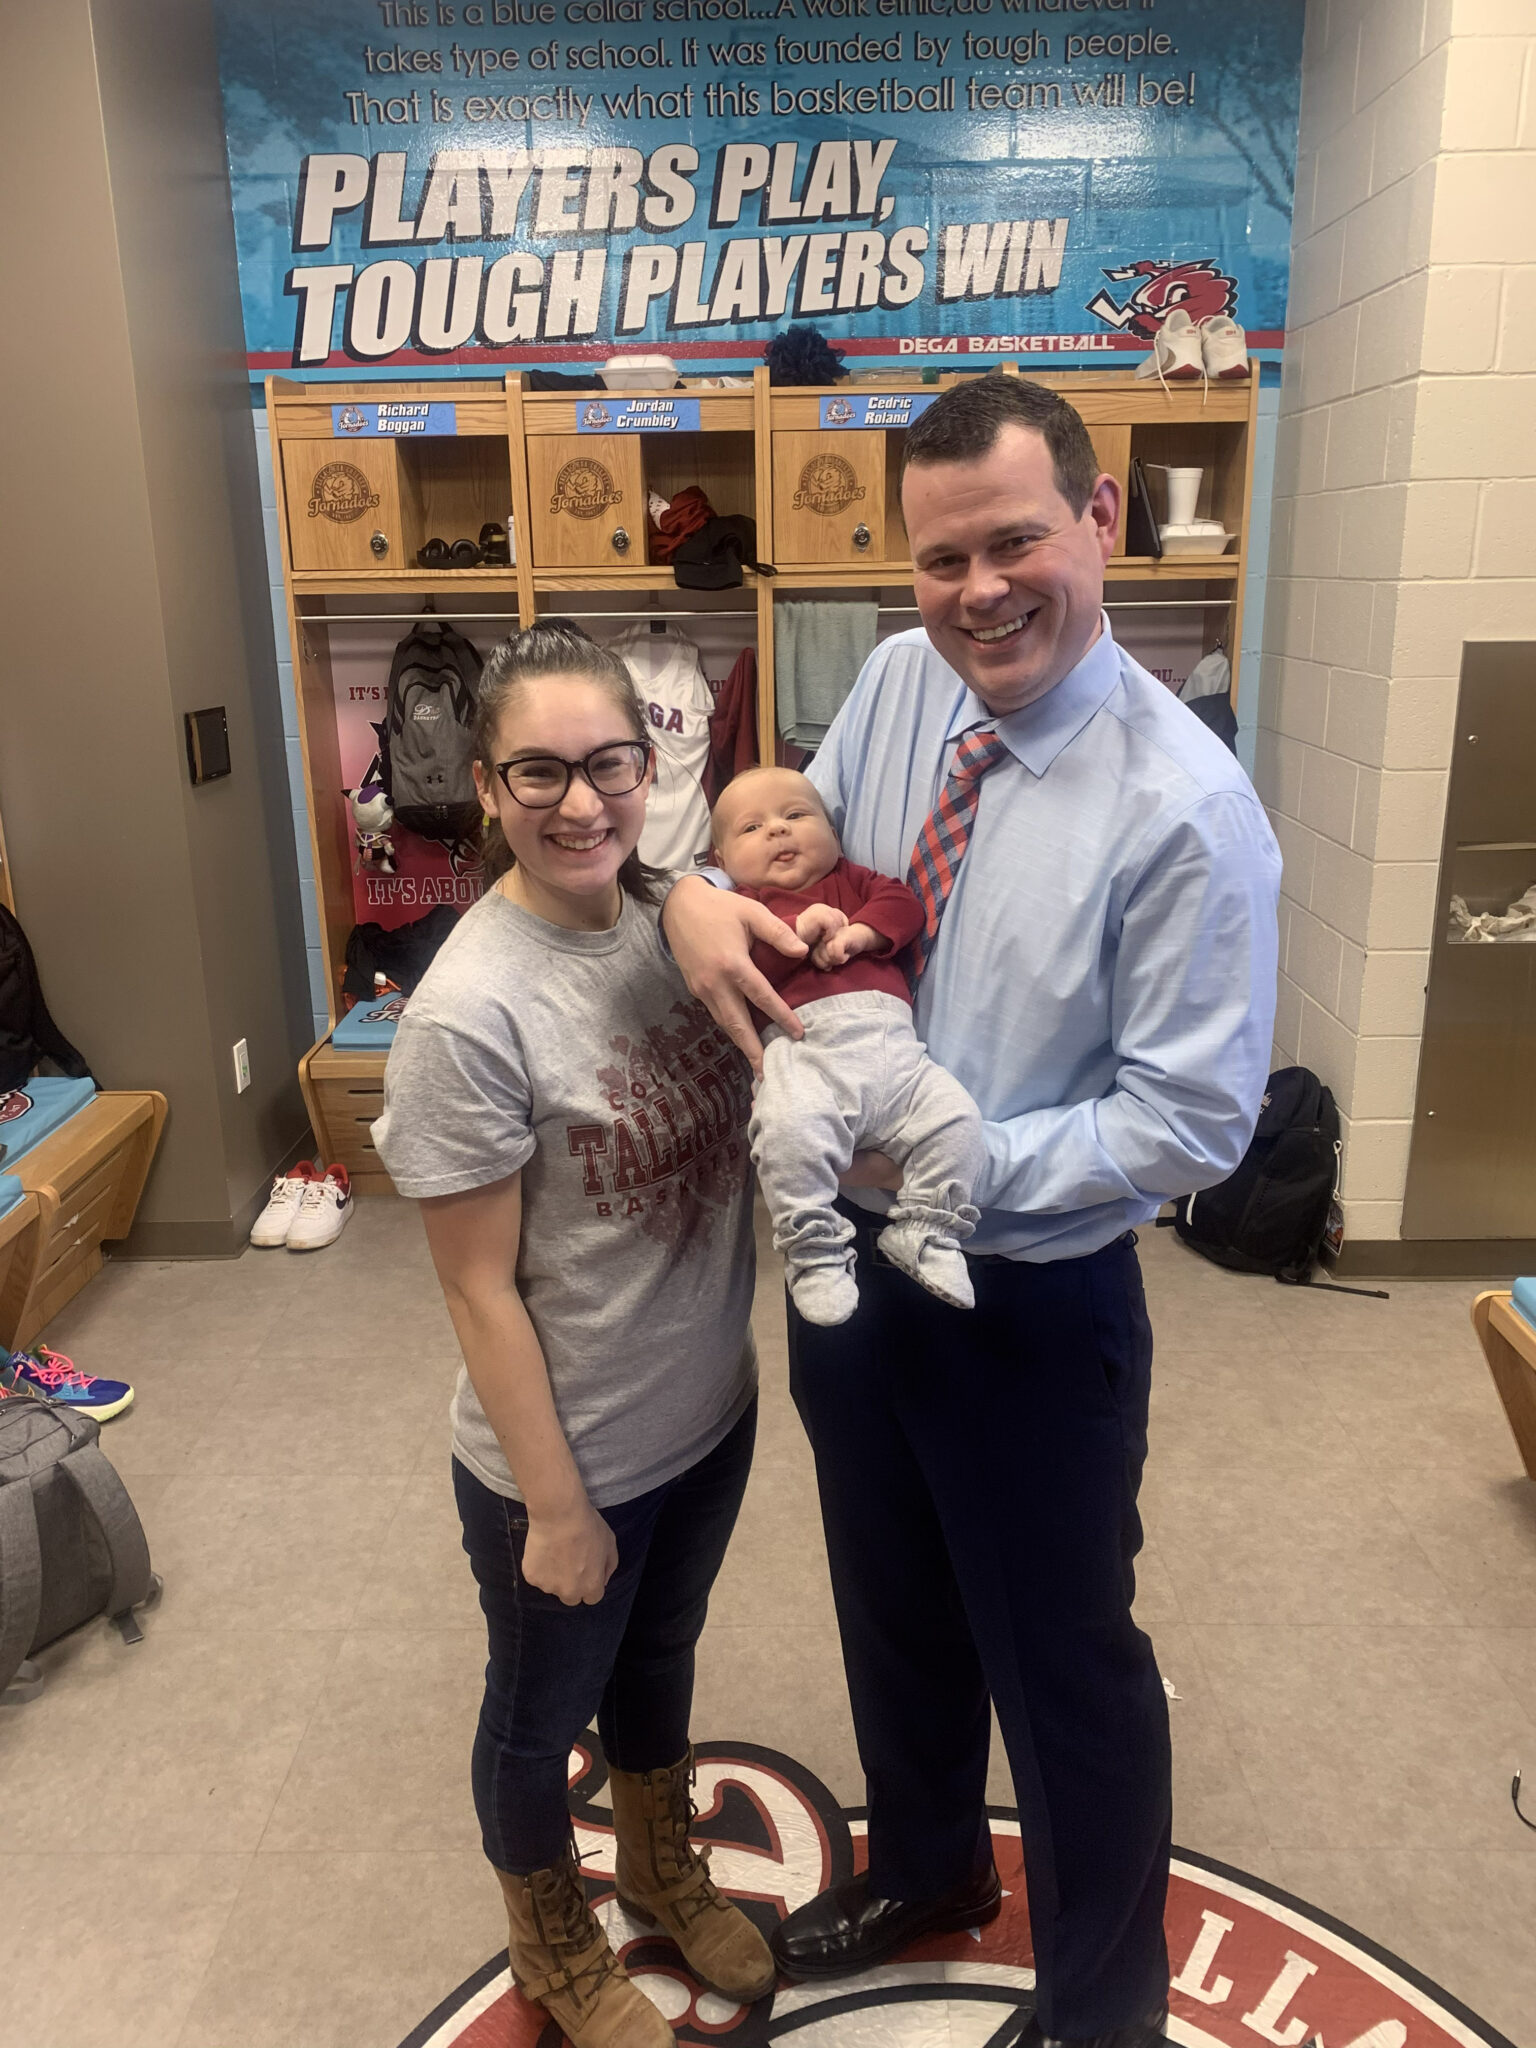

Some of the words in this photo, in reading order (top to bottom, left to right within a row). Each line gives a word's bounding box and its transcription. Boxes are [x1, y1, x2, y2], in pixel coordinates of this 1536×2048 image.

[380, 0, 429, 27] This
[436, 0, 455, 26] is
[463, 5, 484, 25] a
[492, 0, 556, 25] blue
[566, 0, 645, 23] collar
[804, 0, 870, 17] work
[365, 44, 443, 75] takes
[452, 43, 520, 79] type
[528, 41, 559, 70] of
[566, 38, 674, 69] school.
[682, 38, 700, 67] It
[708, 43, 767, 66] was
[775, 33, 903, 64] founded
[914, 31, 952, 66] by
[963, 28, 1051, 64] tough
[1064, 27, 1179, 63] people.
[344, 90, 421, 125] That
[430, 89, 453, 124] is
[463, 87, 594, 128] exactly
[601, 83, 694, 119] what
[704, 81, 761, 117] this
[771, 78, 955, 116] basketball
[966, 77, 1063, 110] team
[1070, 74, 1126, 107] will
[1136, 72, 1196, 106] be!
[292, 143, 699, 252] PLAYERS
[709, 138, 898, 228] PLAY,
[284, 247, 607, 368] TOUGH
[614, 224, 929, 336] PLAYERS
[935, 217, 1070, 305] WIN
[899, 337, 958, 354] DEGA
[968, 335, 1115, 353] BASKETBALL
[377, 403, 430, 417] Richard
[626, 399, 675, 413] Jordan
[867, 396, 913, 409] Cedric
[377, 419, 426, 434] Boggan
[616, 414, 679, 429] Crumbley
[864, 411, 909, 425] Roland
[308, 493, 380, 517] Tornadoes
[550, 490, 624, 514] Tornadoes
[792, 486, 866, 510] Tornadoes
[349, 686, 380, 700] IT'S
[366, 877, 417, 904] IT'S
[420, 877, 485, 904] ABOU
[567, 1051, 751, 1196] TALLADE
